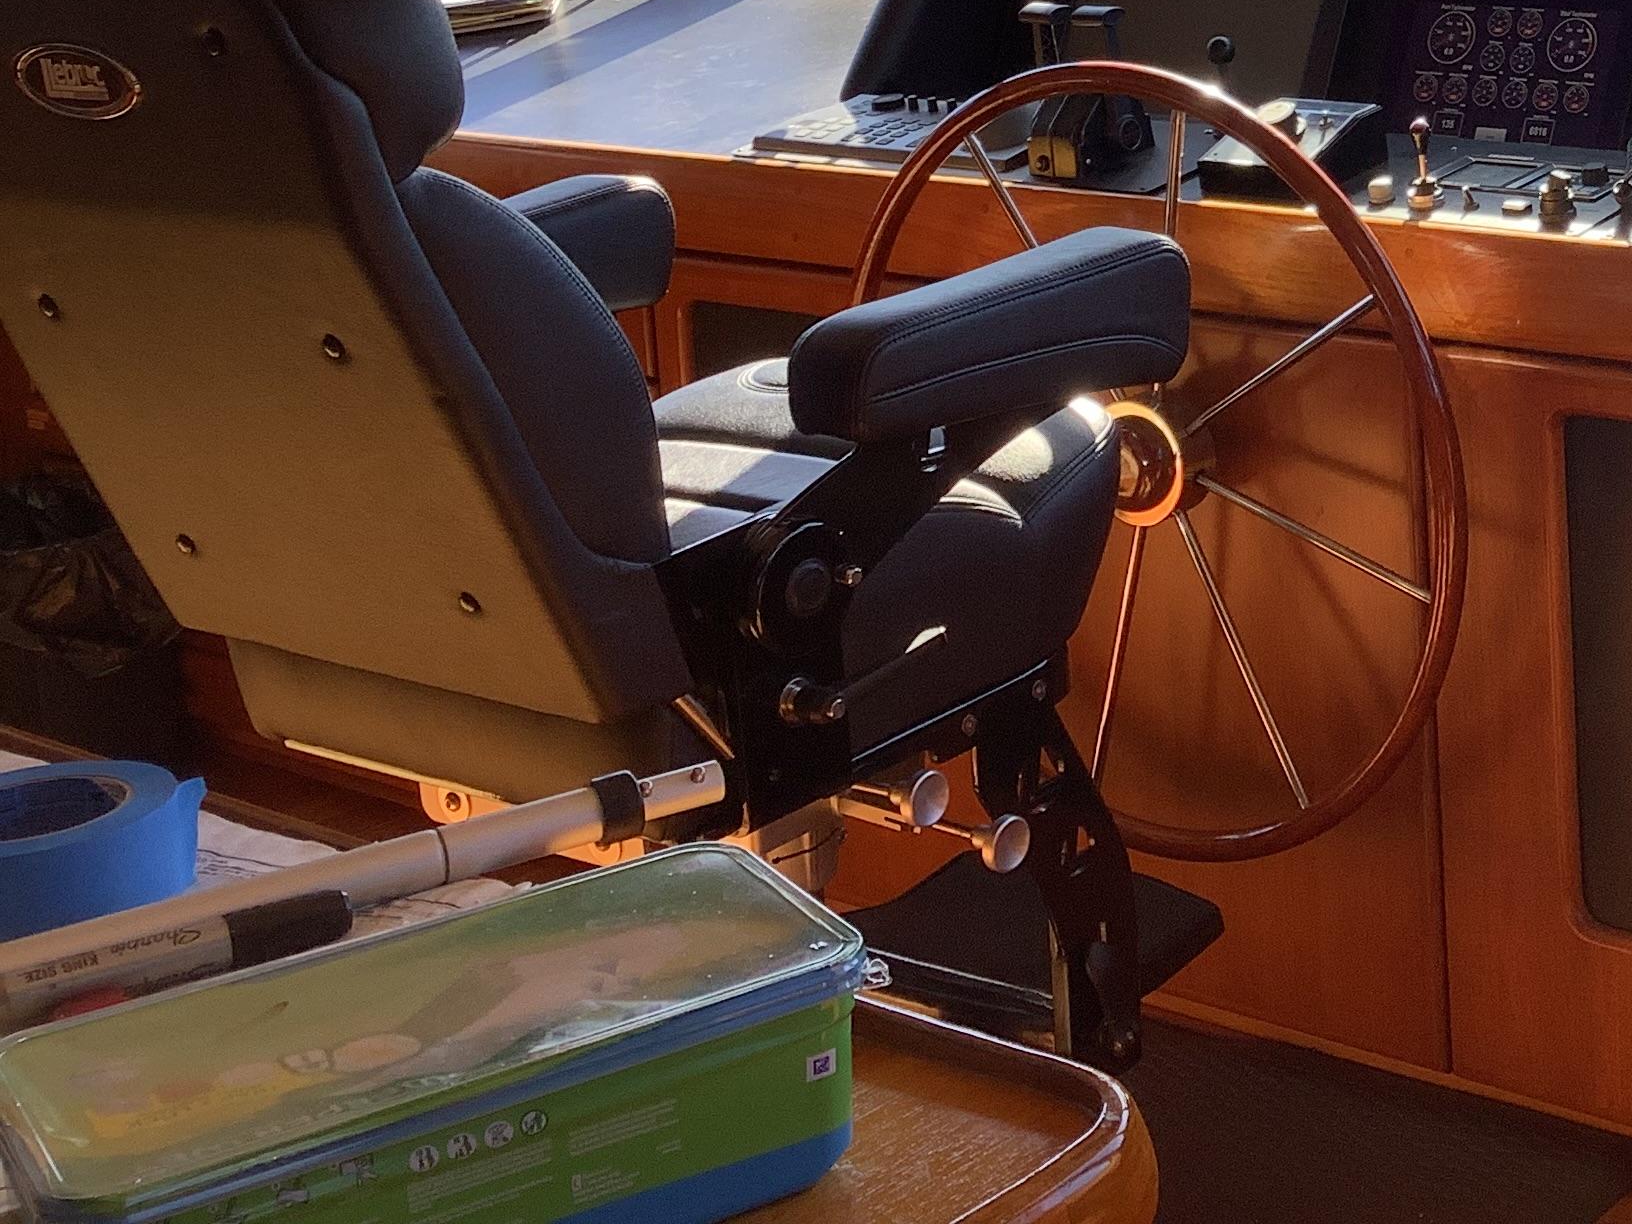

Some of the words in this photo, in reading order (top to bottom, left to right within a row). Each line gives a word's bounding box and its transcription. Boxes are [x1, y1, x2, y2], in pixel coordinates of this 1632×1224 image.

[108, 927, 202, 956] Sharpie
[61, 953, 99, 974] KING
[23, 967, 58, 984] SIZE
